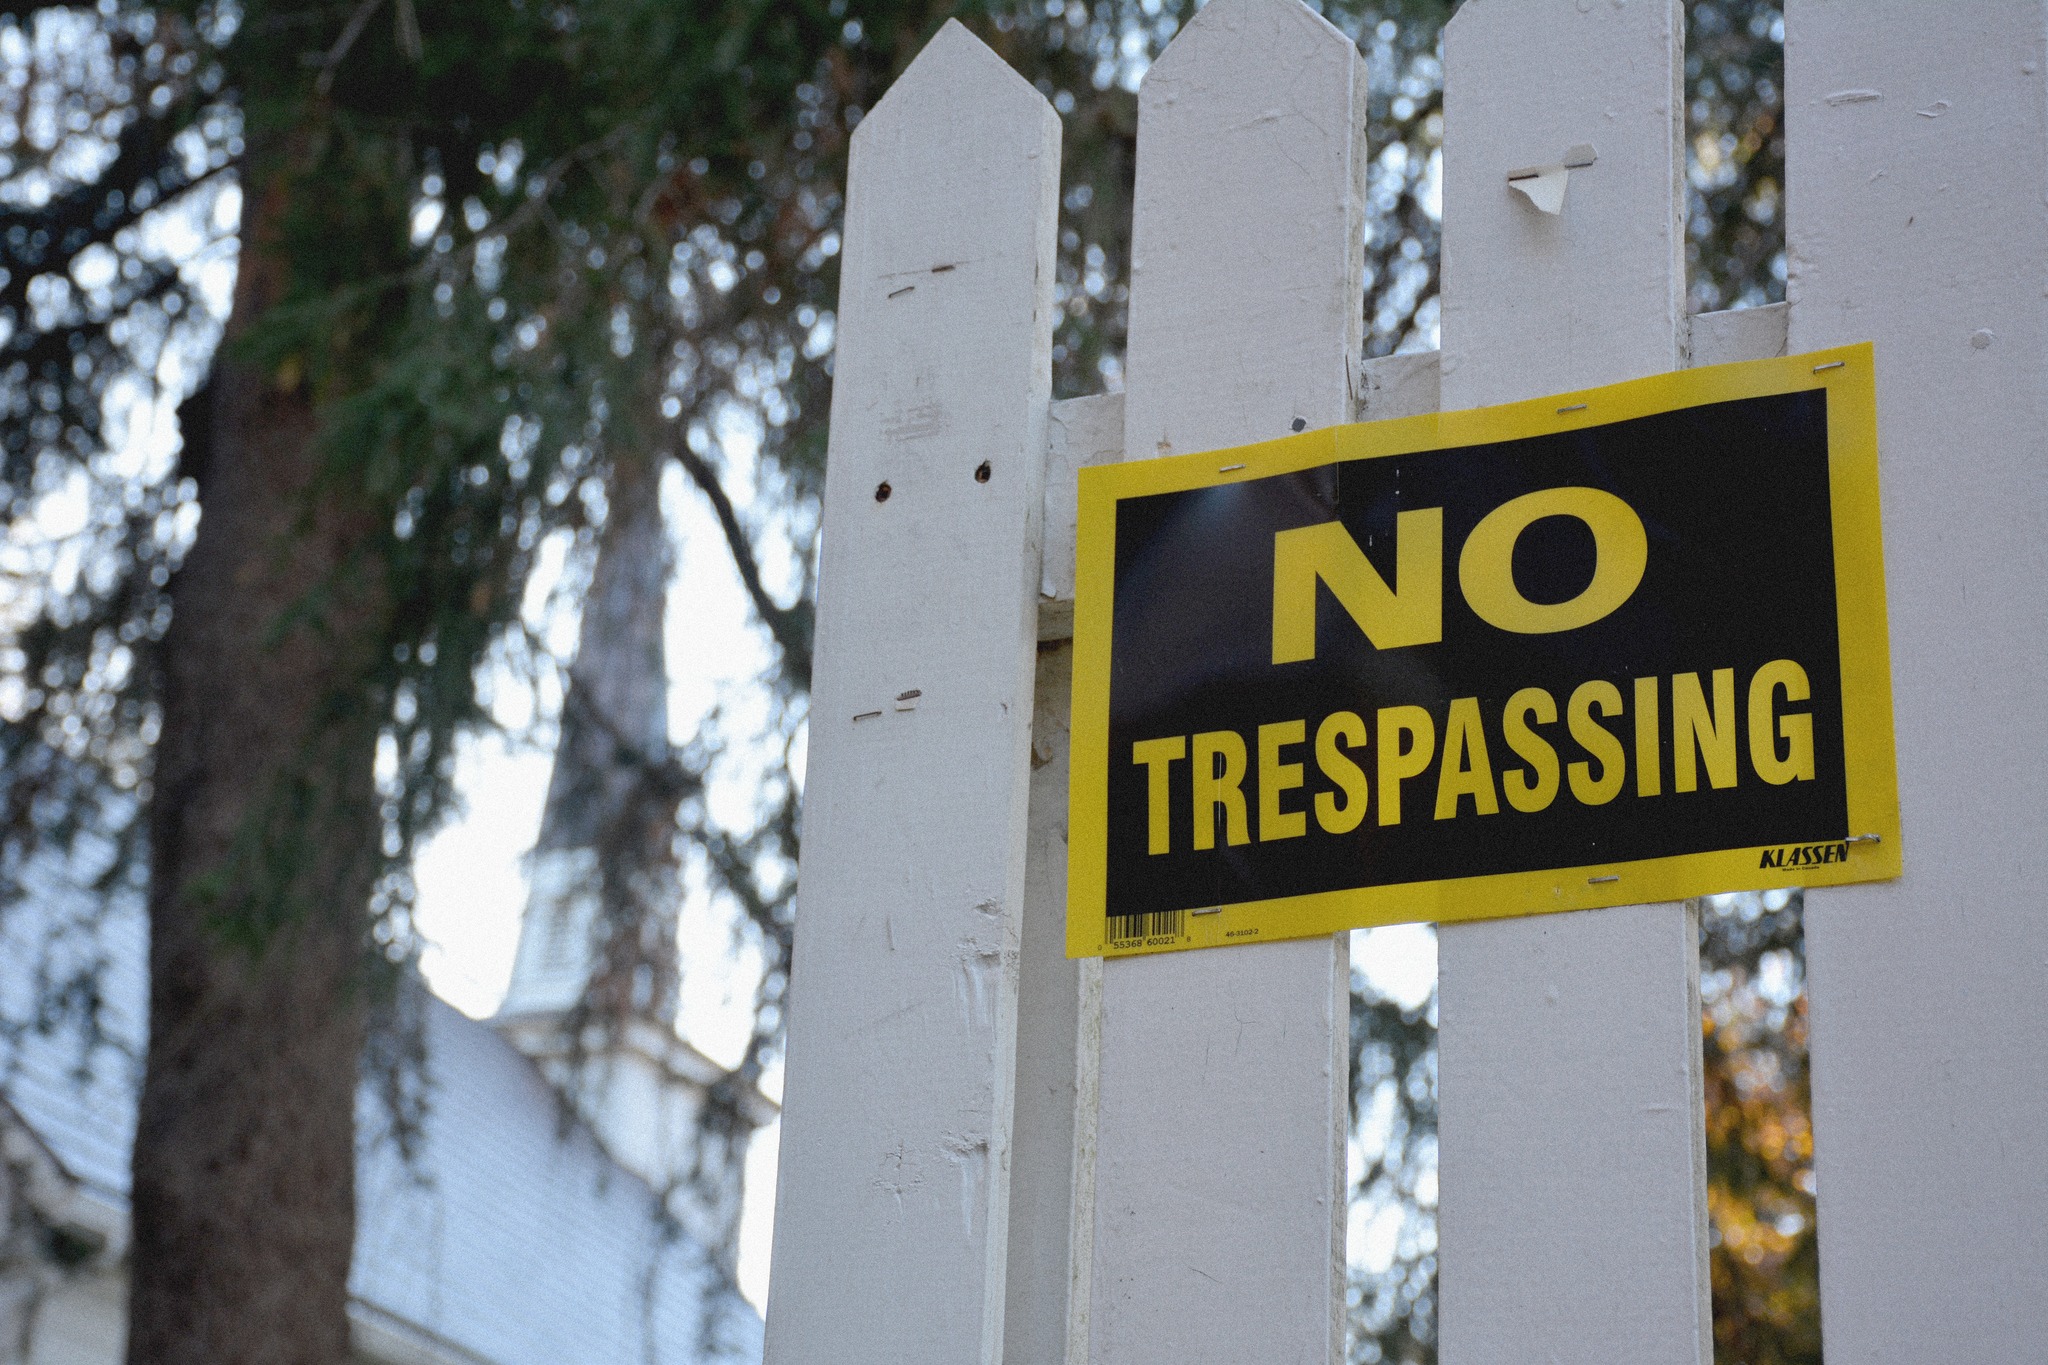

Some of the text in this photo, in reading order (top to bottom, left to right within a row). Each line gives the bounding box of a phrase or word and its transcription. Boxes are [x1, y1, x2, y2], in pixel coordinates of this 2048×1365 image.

[1271, 486, 1648, 665] NO
[1132, 659, 1816, 855] TRESPASSING
[1759, 841, 1849, 868] KLASSEN
[1113, 939, 1142, 949] 55368
[1147, 936, 1175, 947] 60021
[1225, 928, 1259, 937] 46-3102-2
